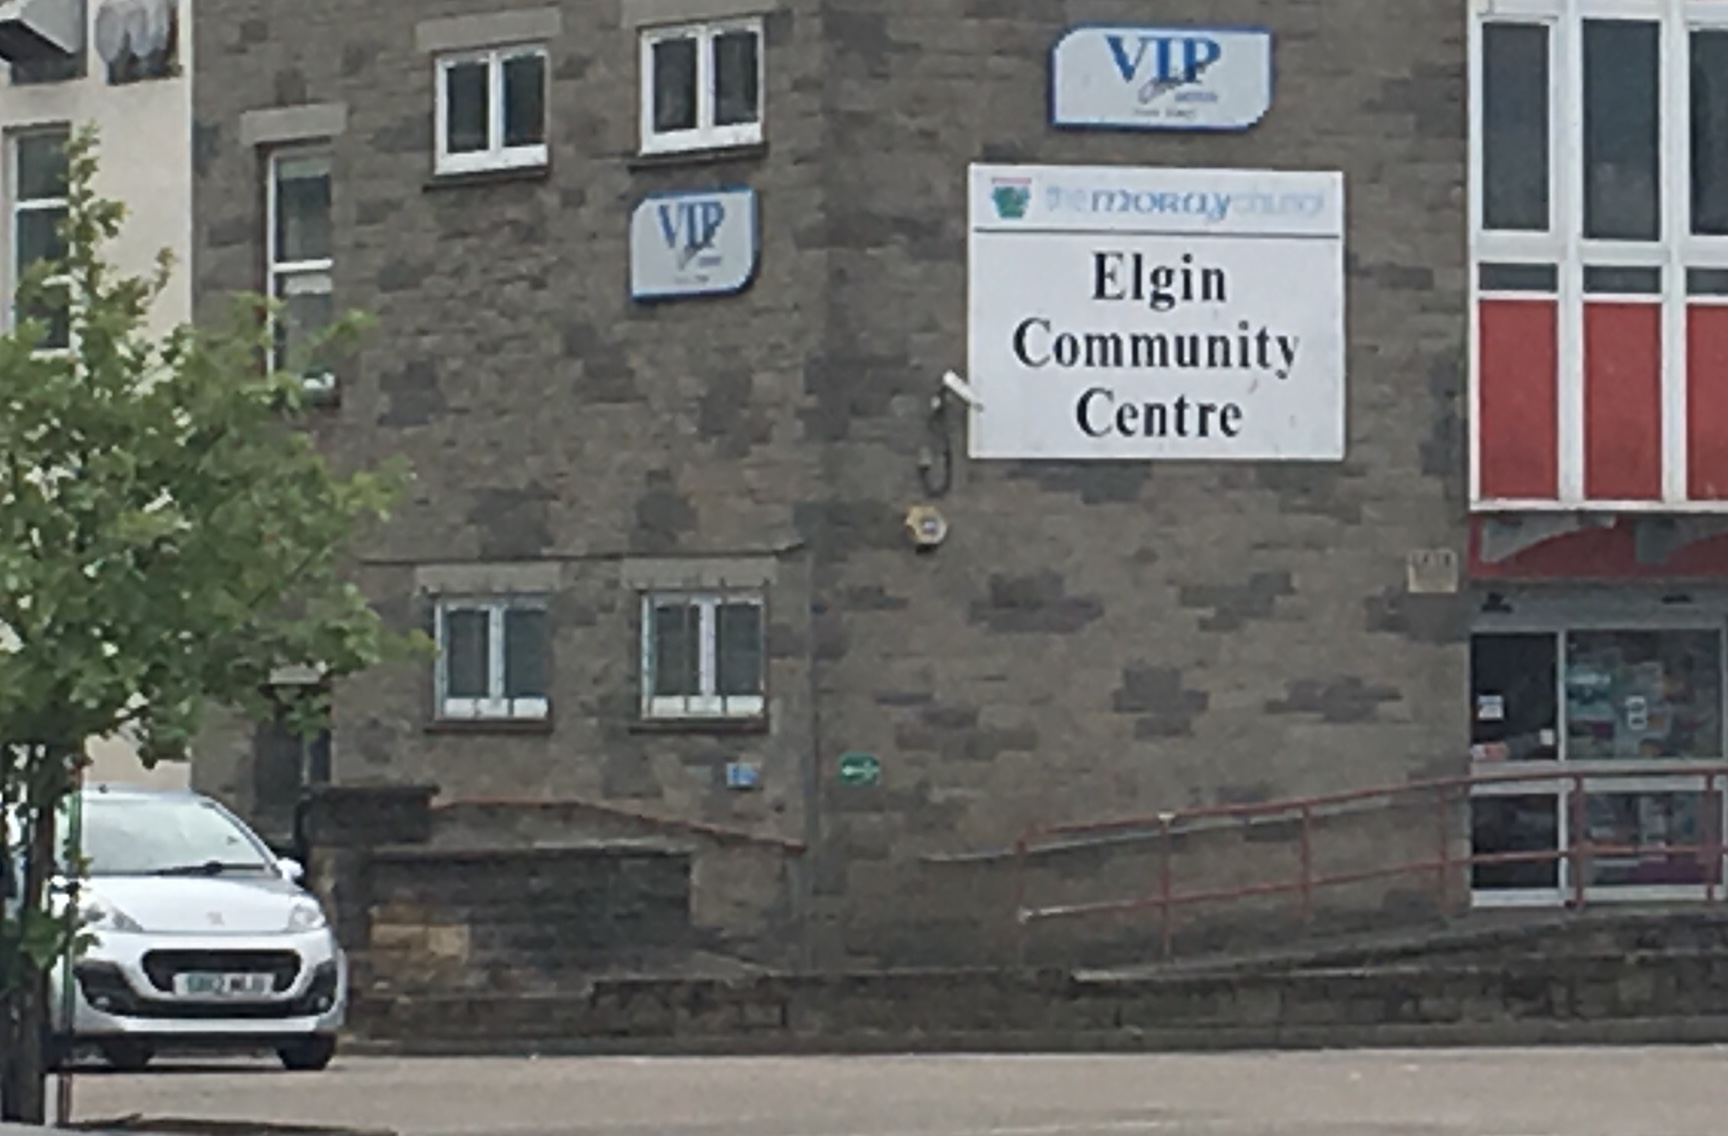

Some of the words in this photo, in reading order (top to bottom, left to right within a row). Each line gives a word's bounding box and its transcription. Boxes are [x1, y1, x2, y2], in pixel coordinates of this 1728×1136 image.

[1104, 34, 1221, 83] VIP
[657, 202, 725, 249] VIP
[1092, 251, 1227, 312] Elgin
[1012, 317, 1300, 380] Community
[1075, 387, 1243, 438] Centre
